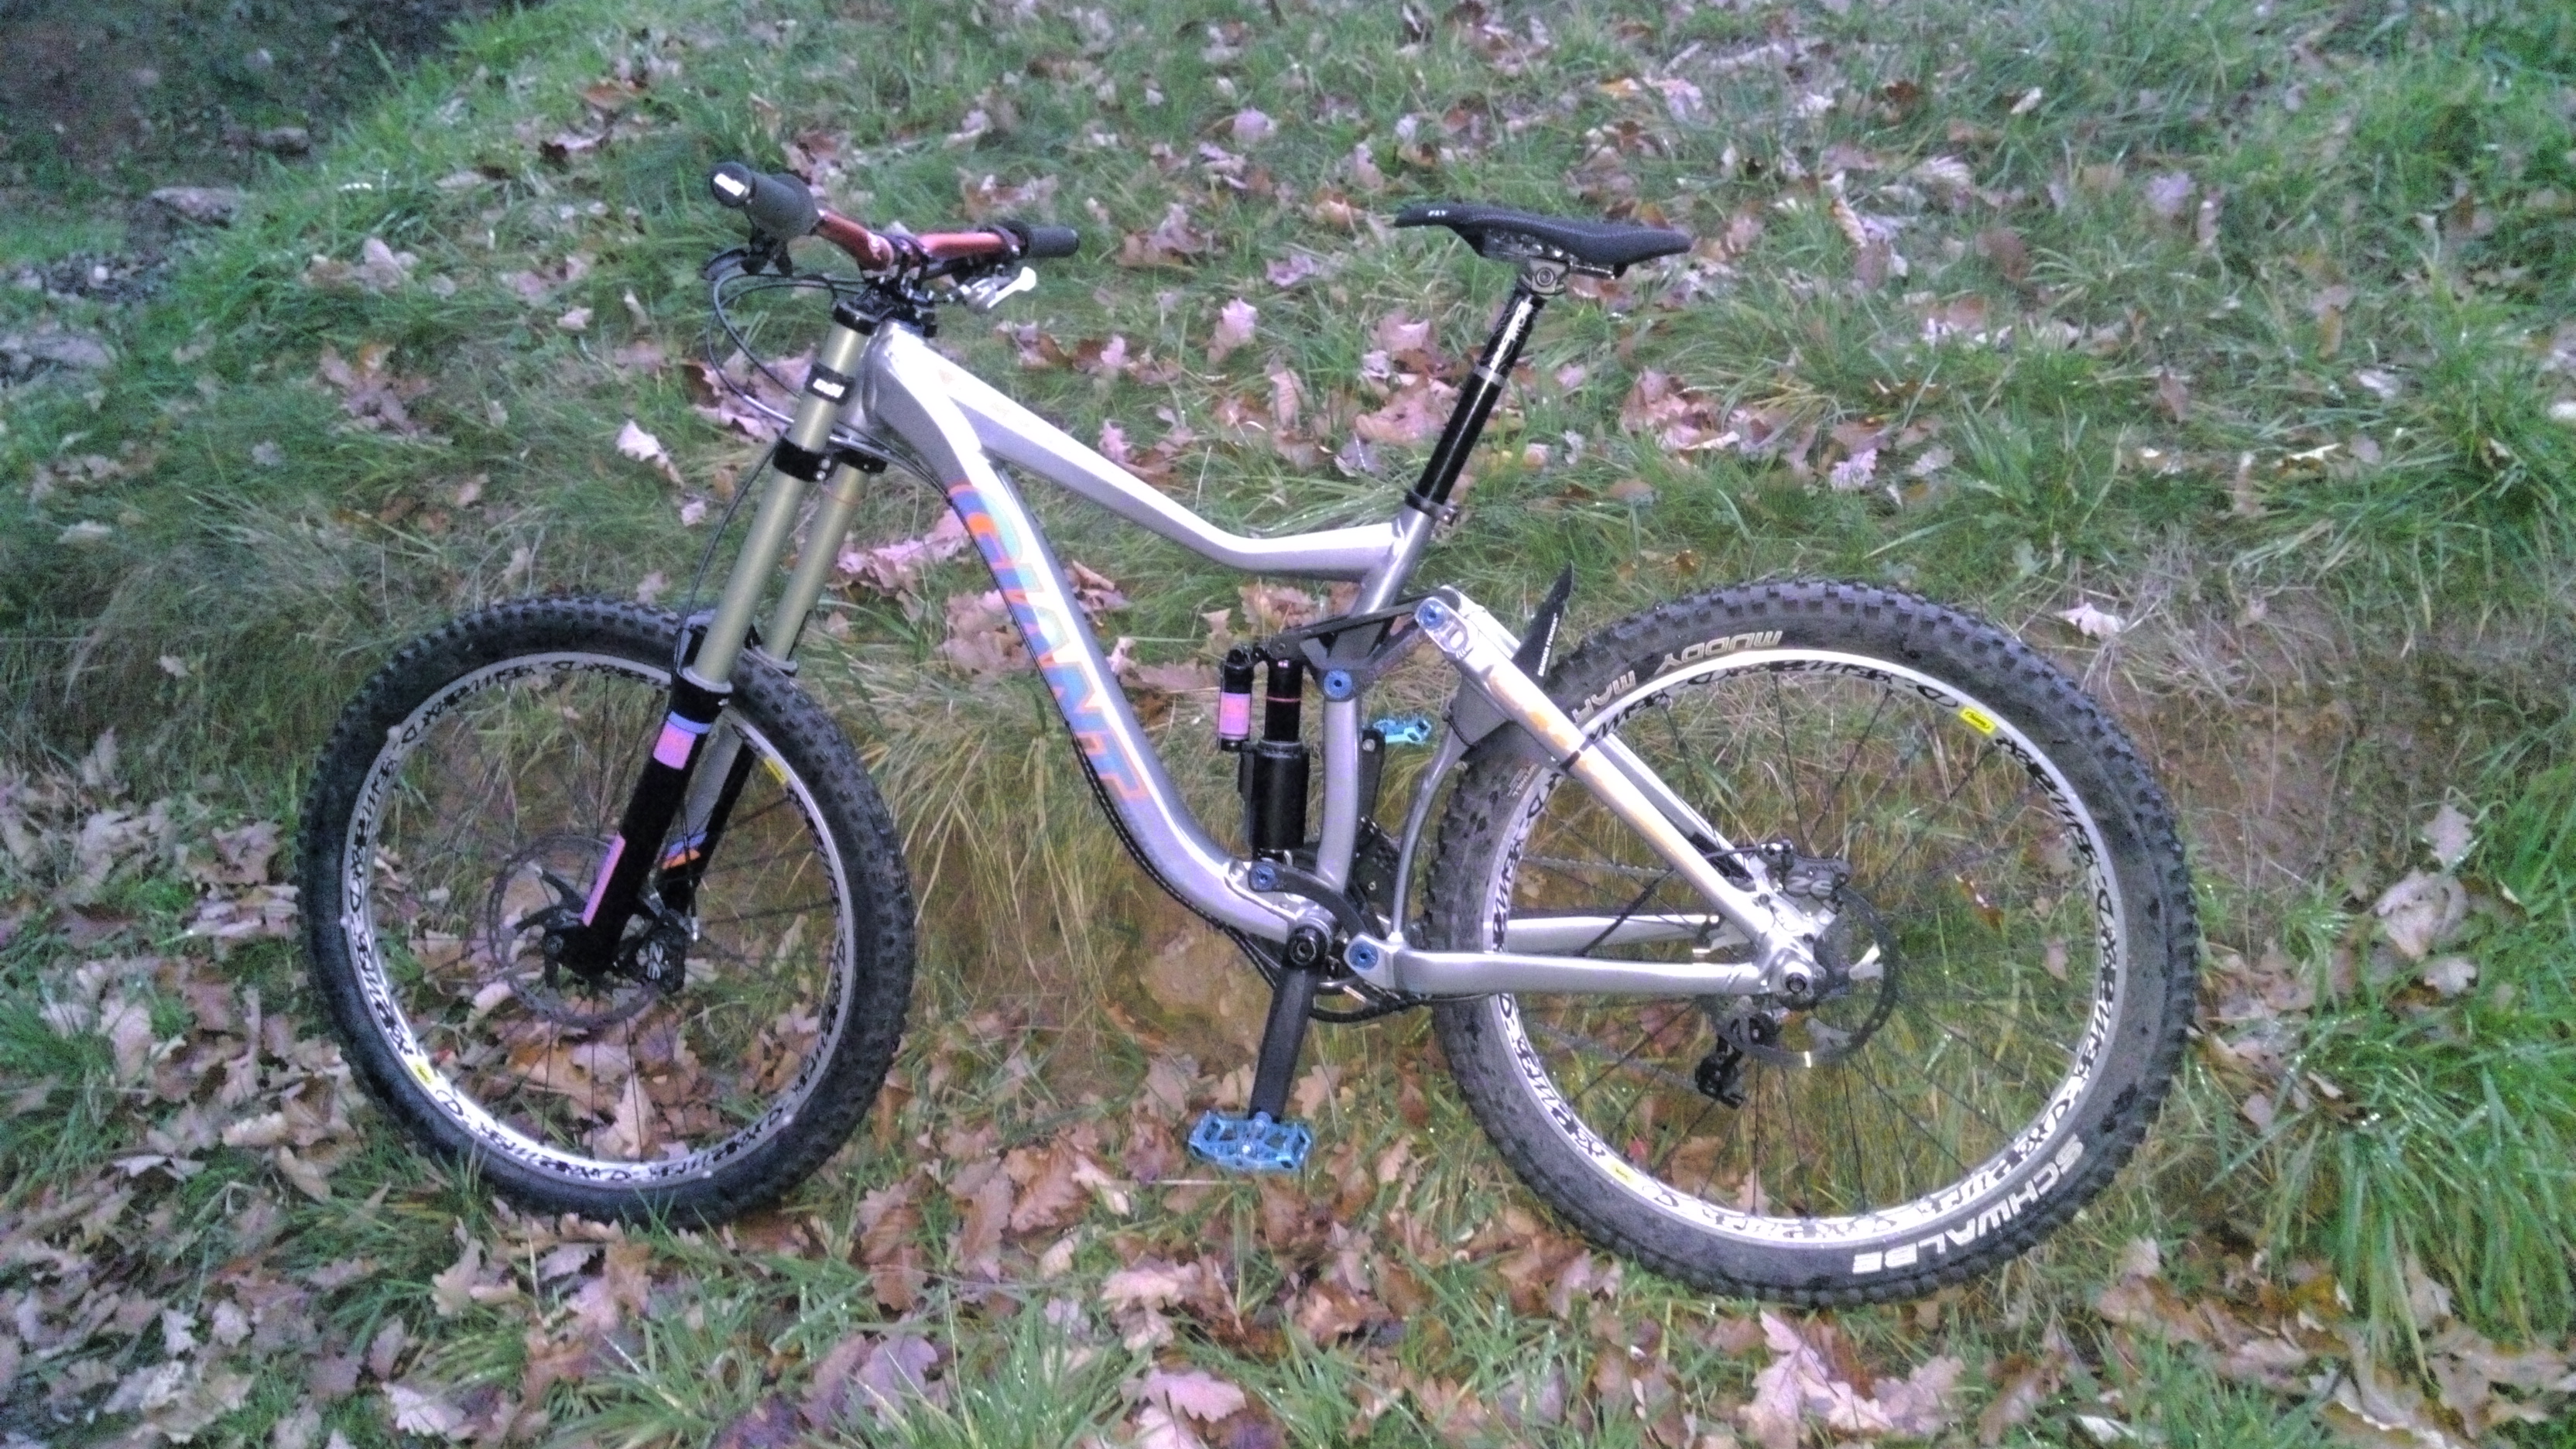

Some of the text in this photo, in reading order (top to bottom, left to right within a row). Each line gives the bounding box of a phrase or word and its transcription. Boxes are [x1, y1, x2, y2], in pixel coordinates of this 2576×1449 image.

[947, 480, 1150, 800] GIANT
[1571, 630, 1783, 726] MUDDY MAR
[1851, 1132, 2085, 1274] SCHWALBE
